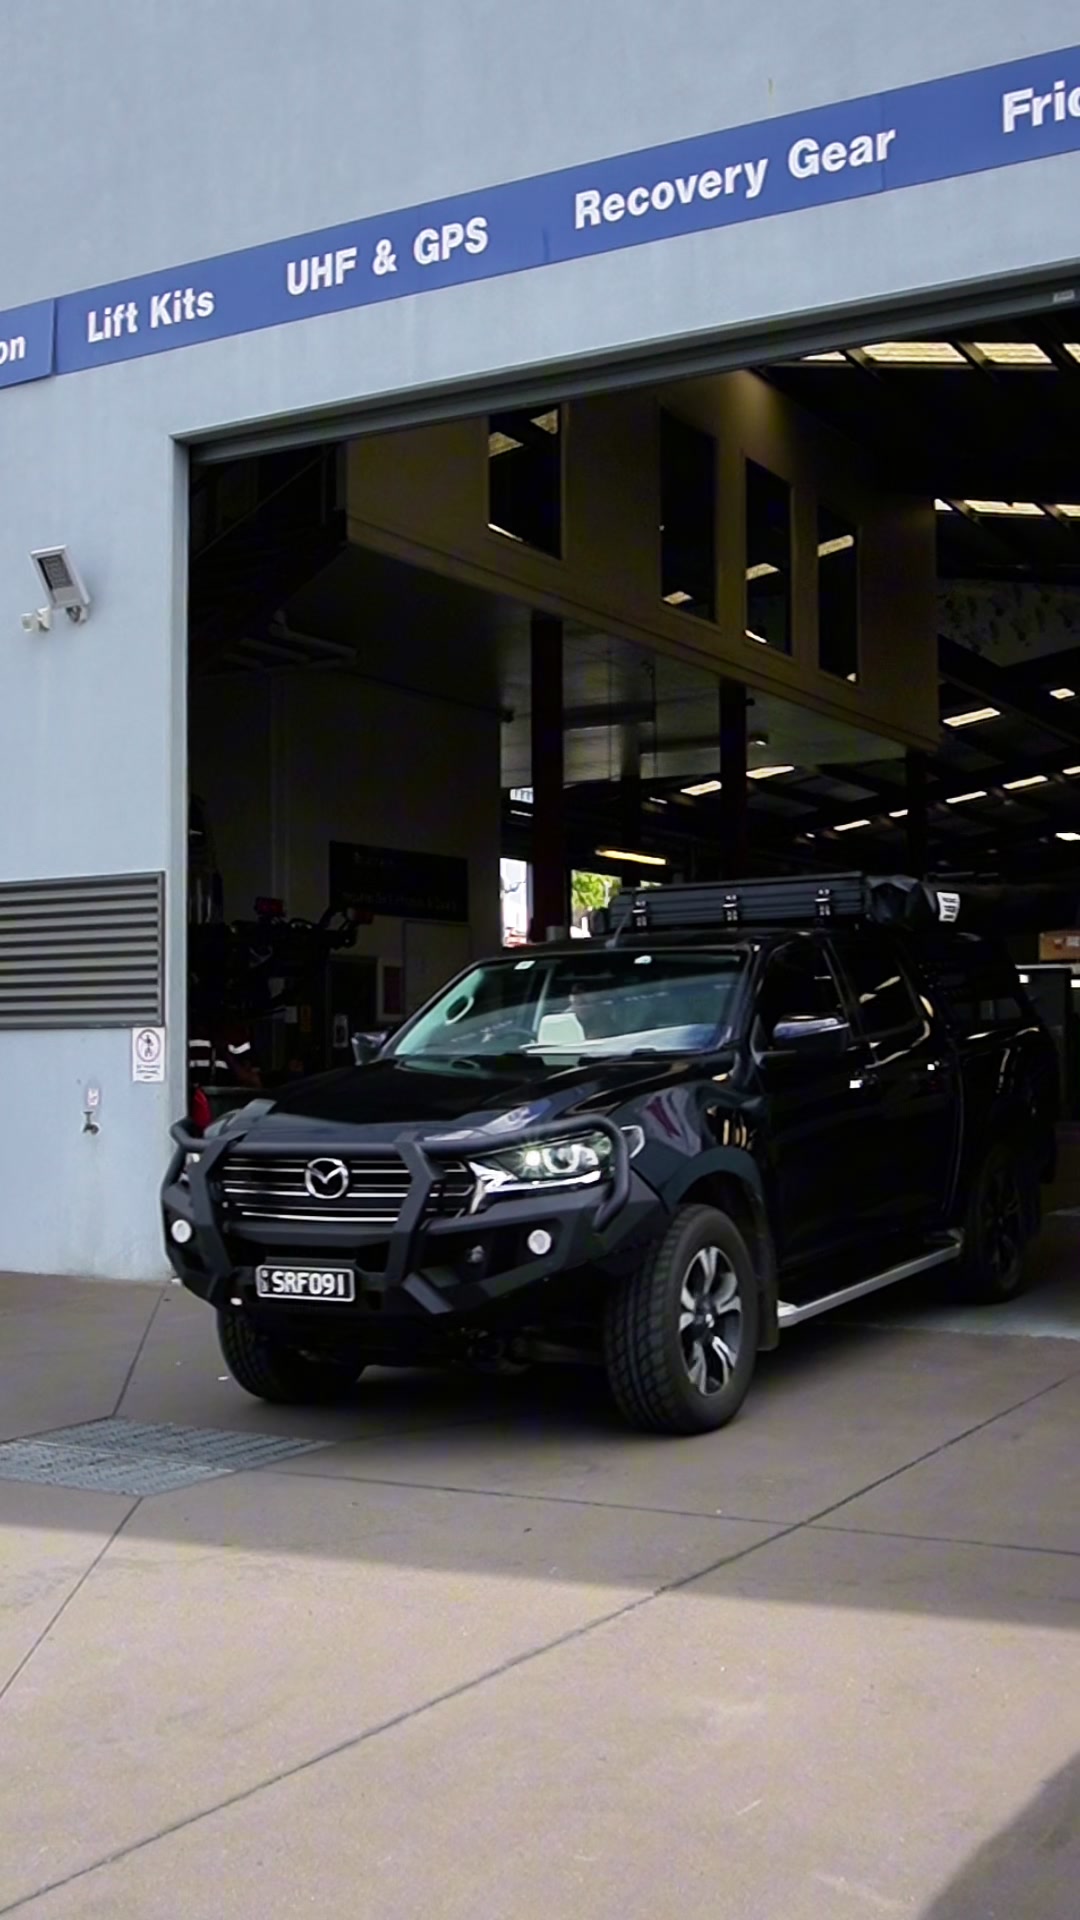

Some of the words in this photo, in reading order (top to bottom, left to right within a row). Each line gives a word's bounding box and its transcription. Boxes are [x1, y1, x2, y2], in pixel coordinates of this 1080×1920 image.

[575, 158, 769, 230] Recovery
[788, 129, 896, 179] Gear
[287, 246, 358, 296] UHF
[372, 238, 399, 276] &
[413, 216, 489, 265] GPS
[87, 301, 139, 343] Lift
[150, 287, 215, 329] Kits
